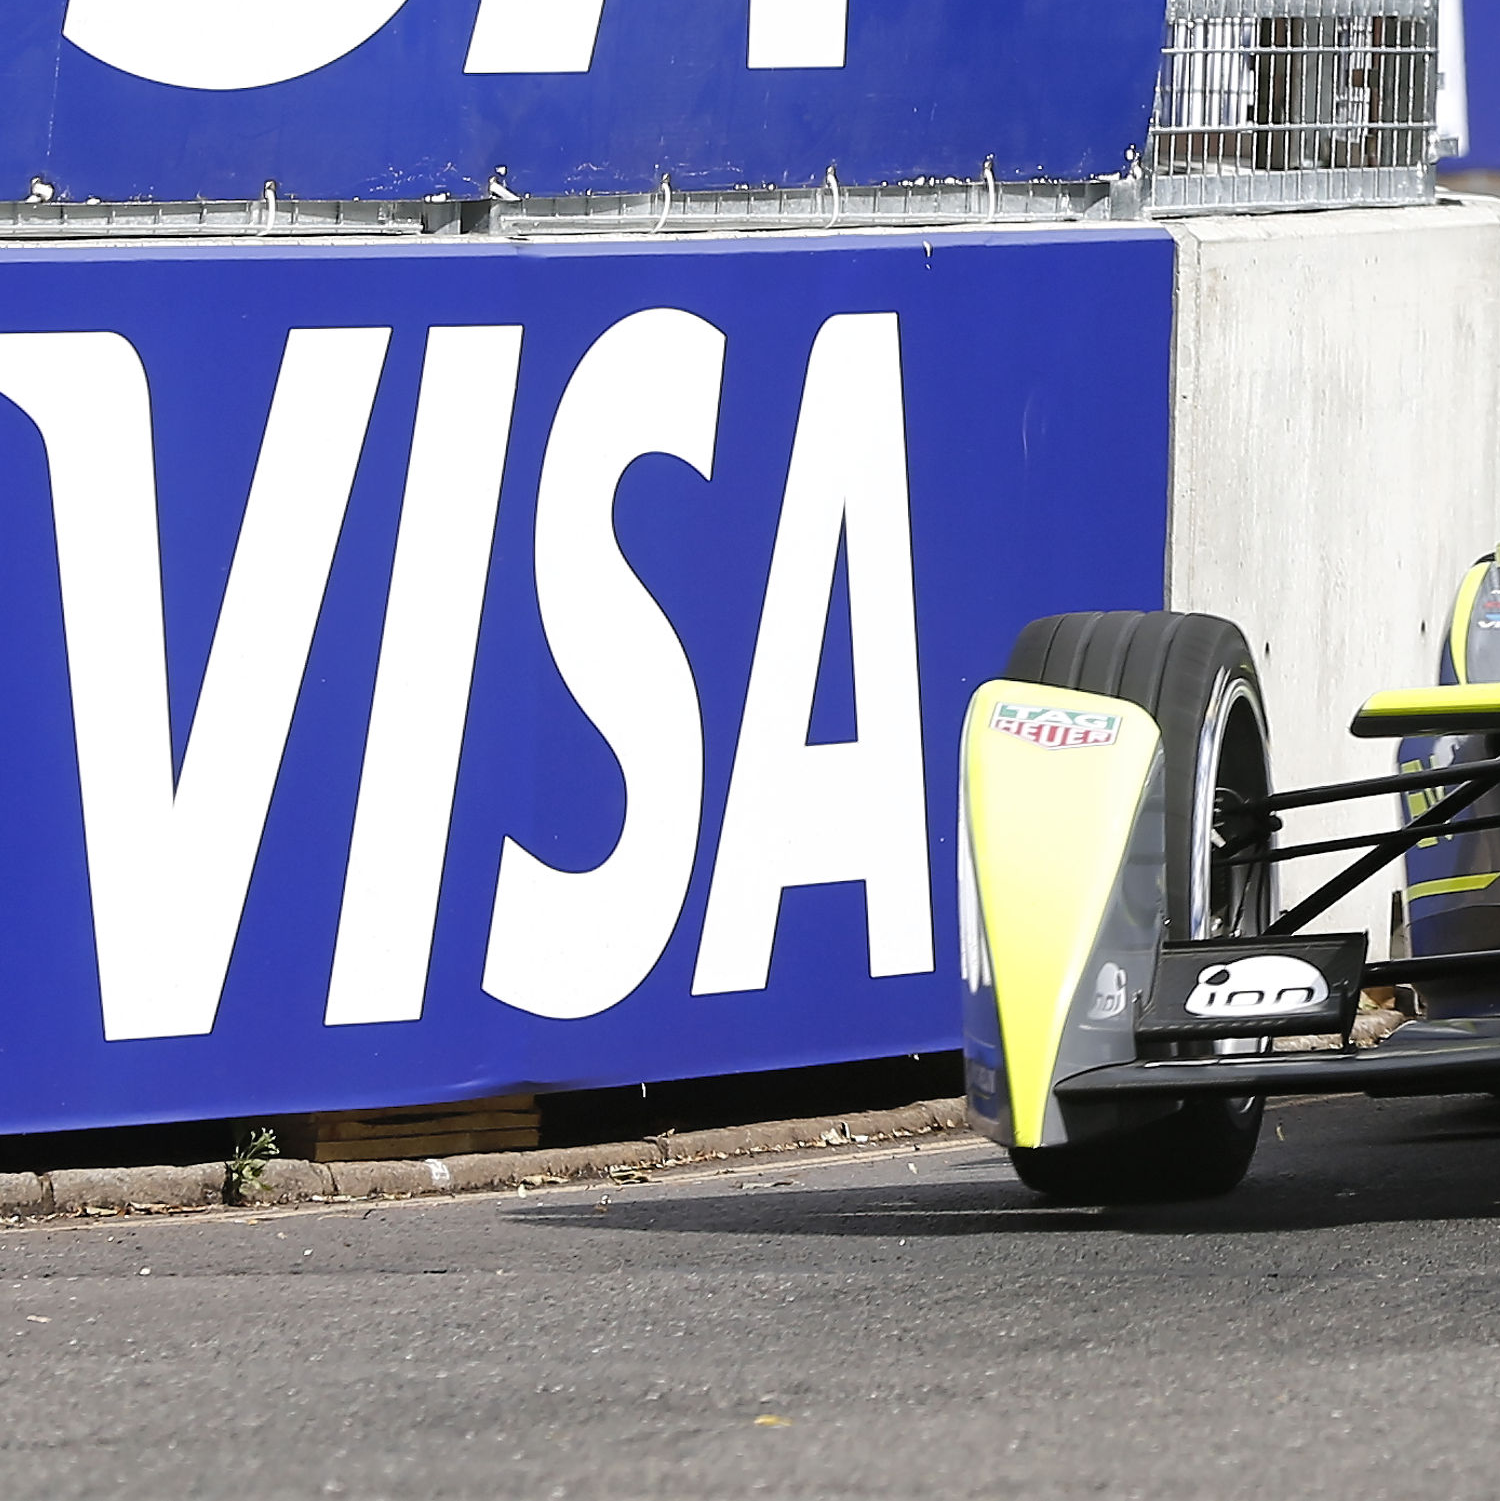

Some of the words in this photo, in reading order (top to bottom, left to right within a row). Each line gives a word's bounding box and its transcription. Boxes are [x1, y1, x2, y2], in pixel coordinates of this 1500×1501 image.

[0, 308, 935, 1042] VISA
[1010, 704, 1109, 728] TAG
[1000, 719, 1112, 747] HEUER
